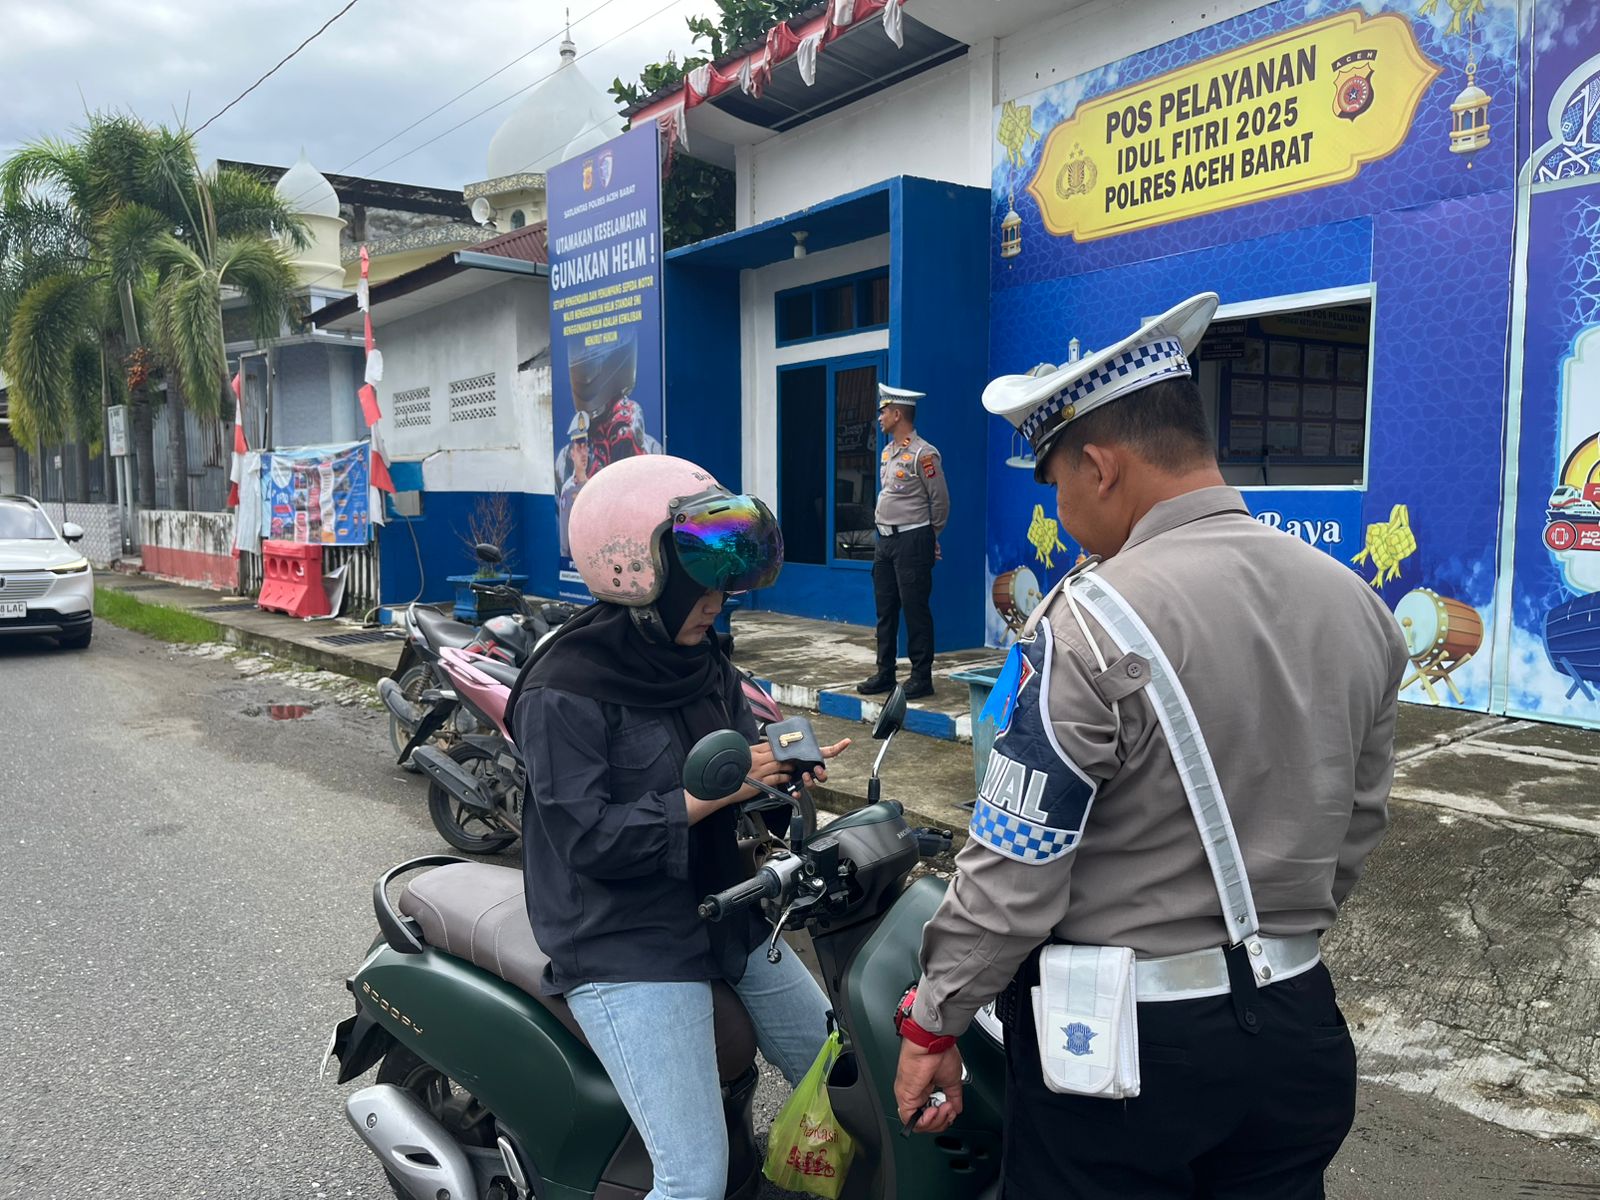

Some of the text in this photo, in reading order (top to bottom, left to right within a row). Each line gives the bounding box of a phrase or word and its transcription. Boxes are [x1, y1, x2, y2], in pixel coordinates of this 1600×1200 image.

[1336, 51, 1374, 68] ACEH
[1106, 44, 1316, 144] POS PELAYANAN
[1118, 96, 1298, 175] IDUL FITRI 2025
[1105, 131, 1313, 213] POLRES ACEH BARAT
[556, 208, 646, 255] UTAMAKAN KESELAMATAN
[551, 249, 608, 291] GUNAKAN
[612, 236, 646, 274] HELM
[1256, 511, 1342, 546] Raya
[362, 981, 423, 1036] SCOOPY
